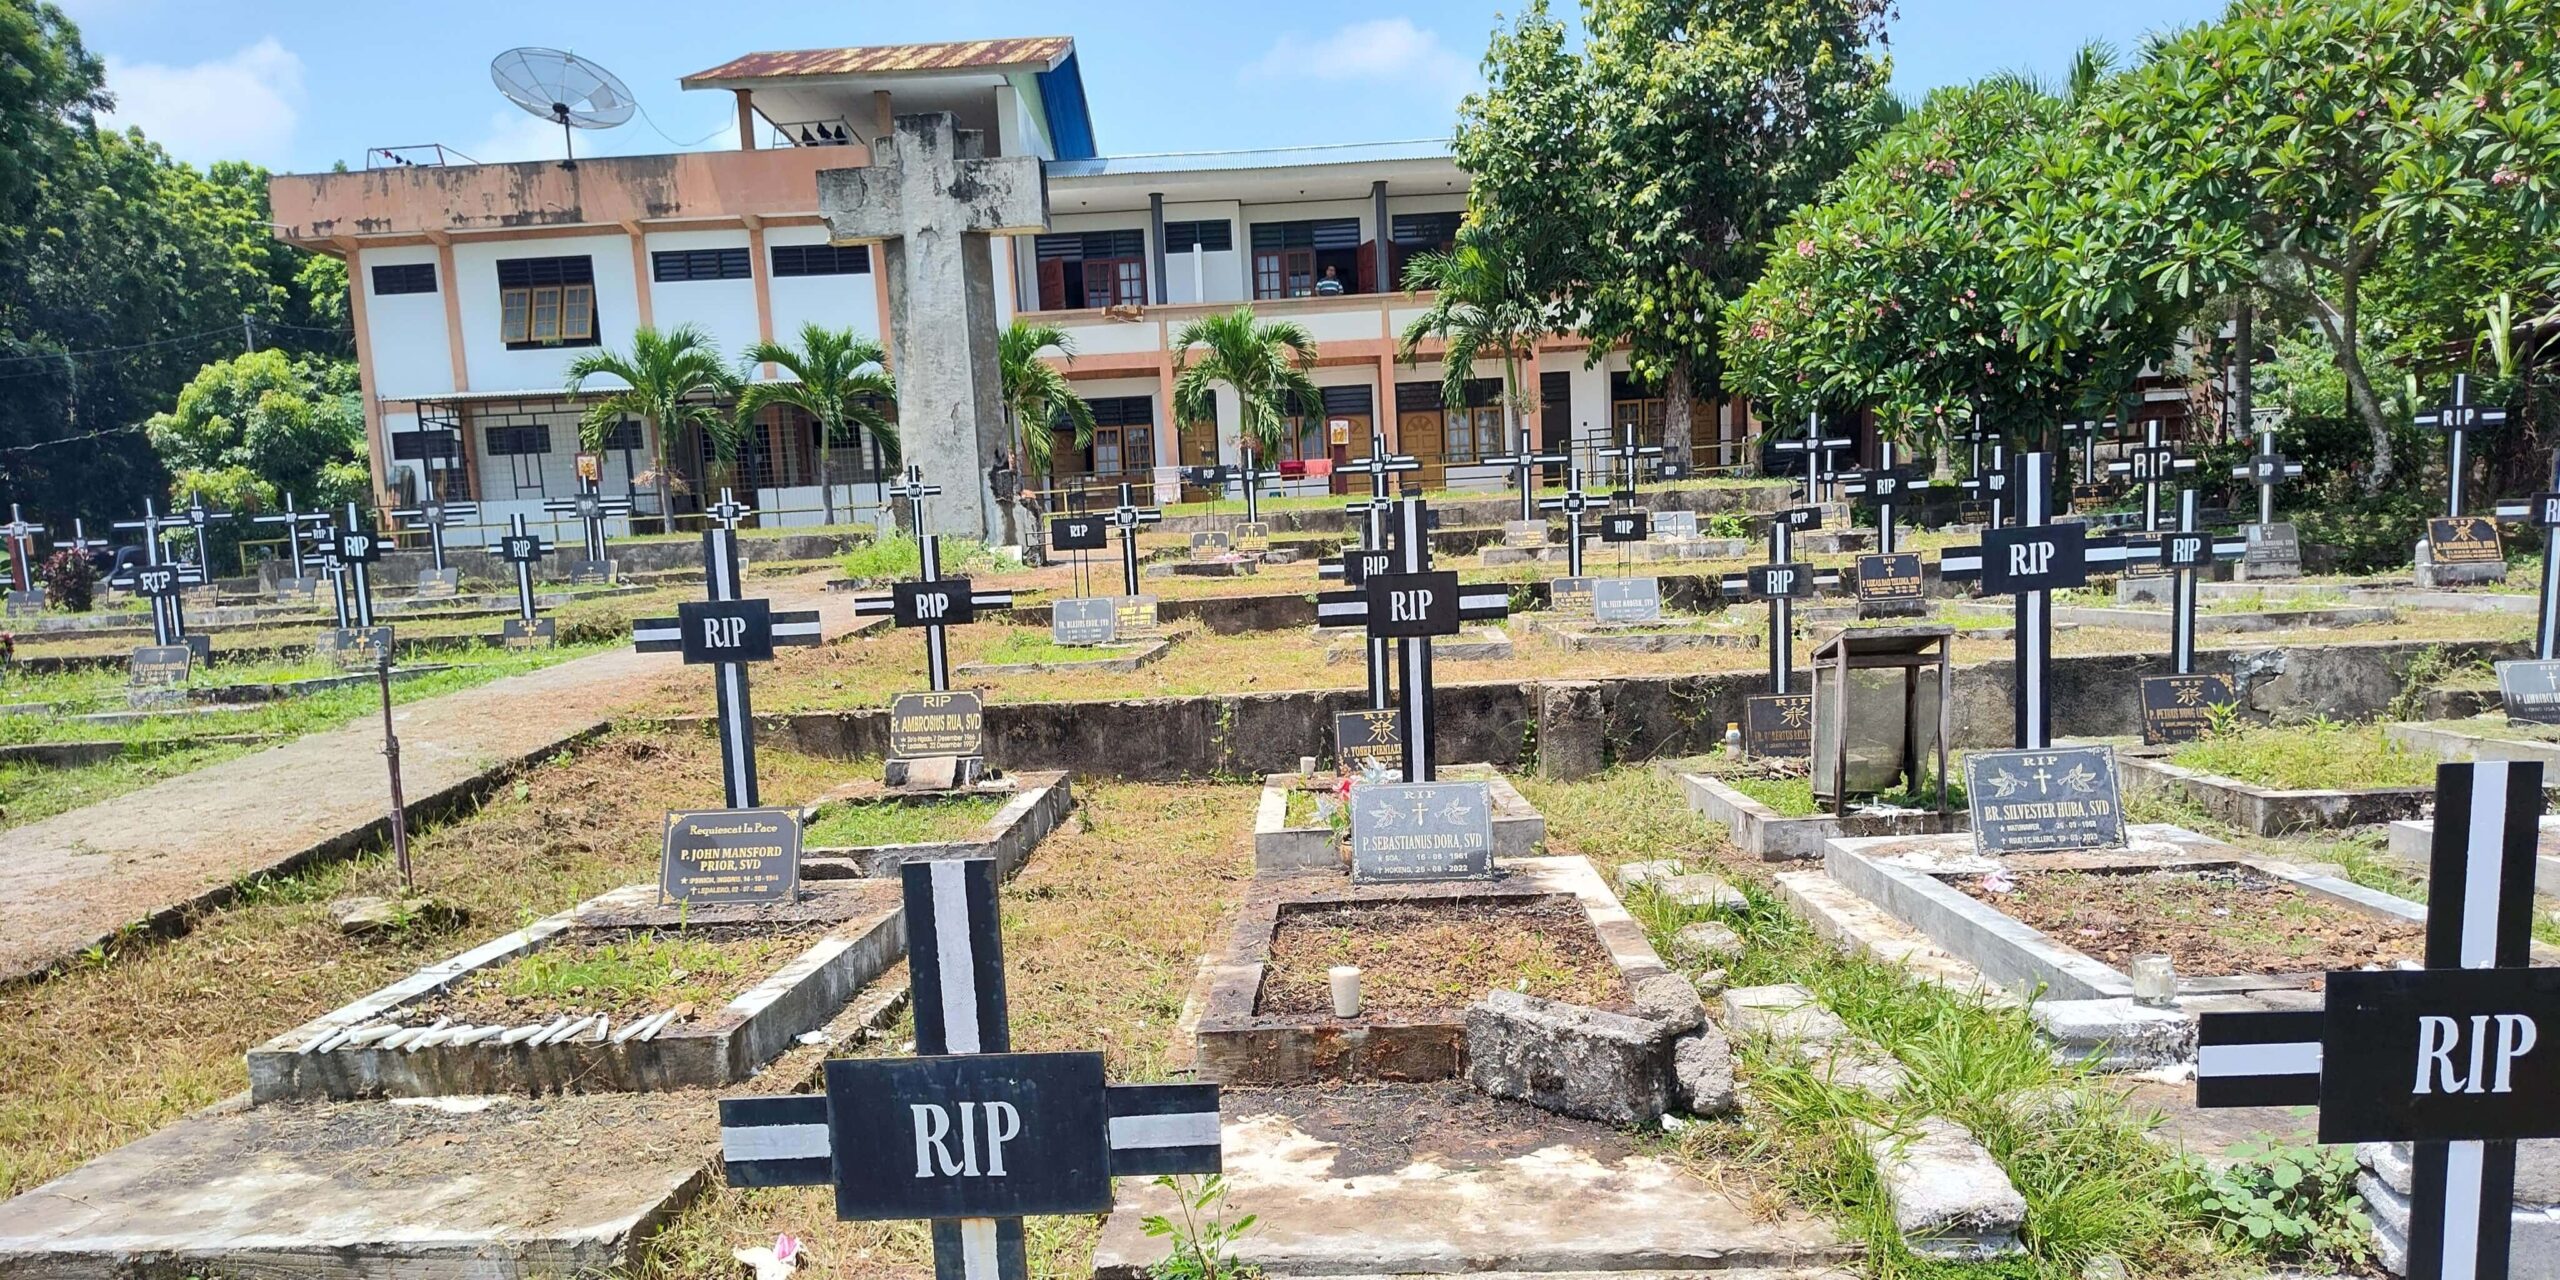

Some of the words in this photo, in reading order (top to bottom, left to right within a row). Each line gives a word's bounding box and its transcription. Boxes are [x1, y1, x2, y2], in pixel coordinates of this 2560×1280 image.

[2443, 408, 2474, 426] RIP
[1807, 439, 1818, 449] RIP
[1520, 455, 1532, 465] RIP
[2134, 452, 2171, 478] RIP
[1202, 468, 1214, 479] RIP
[1371, 464, 1383, 474] RIP
[1665, 466, 1677, 476] RIP
[2258, 463, 2273, 477] RIP
[1823, 472, 1834, 481] RIP
[1989, 475, 2005, 490] RIP
[1877, 479, 1896, 495] RIP
[1569, 499, 1580, 508] RIP
[1121, 512, 1133, 523] RIP
[1790, 512, 1808, 524] RIP
[313, 529, 326, 539] RIP
[1070, 524, 1088, 538] RIP
[1614, 520, 1634, 534] RIP
[344, 536, 369, 557] RIP
[513, 540, 531, 558] RIP
[2172, 538, 2201, 563] RIP
[2009, 542, 2055, 576] RIP
[1363, 556, 1389, 579] RIP
[140, 571, 170, 593] RIP
[1767, 570, 1794, 594] RIP
[916, 593, 949, 619] RIP
[1391, 590, 1433, 622] RIP
[703, 617, 746, 648] RIP
[923, 695, 951, 708] RIP
[1775, 698, 1811, 706] RIP
[901, 714, 945, 732] AMBROSIUS
[946, 713, 964, 732] RUA,
[965, 713, 981, 730] SVD
[1363, 712, 1396, 720] RIP
[1343, 747, 1350, 757] P.
[2022, 756, 2058, 767] RIP
[1403, 790, 1436, 800] RIP
[1984, 805, 2003, 821] BR.
[2003, 802, 2056, 820] SILVESTER
[2056, 801, 2088, 818] HUBA,
[2090, 800, 2110, 816] SVD
[690, 824, 742, 837] Requiescat
[743, 823, 753, 833] In
[753, 822, 778, 833] Pace
[1363, 837, 1371, 851] P.
[1372, 834, 1432, 851] SEBASTIANUS
[1433, 833, 1462, 850] DORA,
[1464, 833, 1482, 848] SVD
[680, 849, 690, 861] P.
[691, 848, 721, 862] JOHN
[722, 846, 782, 860] MANSFORD
[700, 860, 738, 872] PRIOR,
[739, 859, 762, 870] SVD
[1448, 865, 1468, 873] 2022
[2412, 1013, 2537, 1094] RIP
[910, 1101, 1021, 1179] RIP
